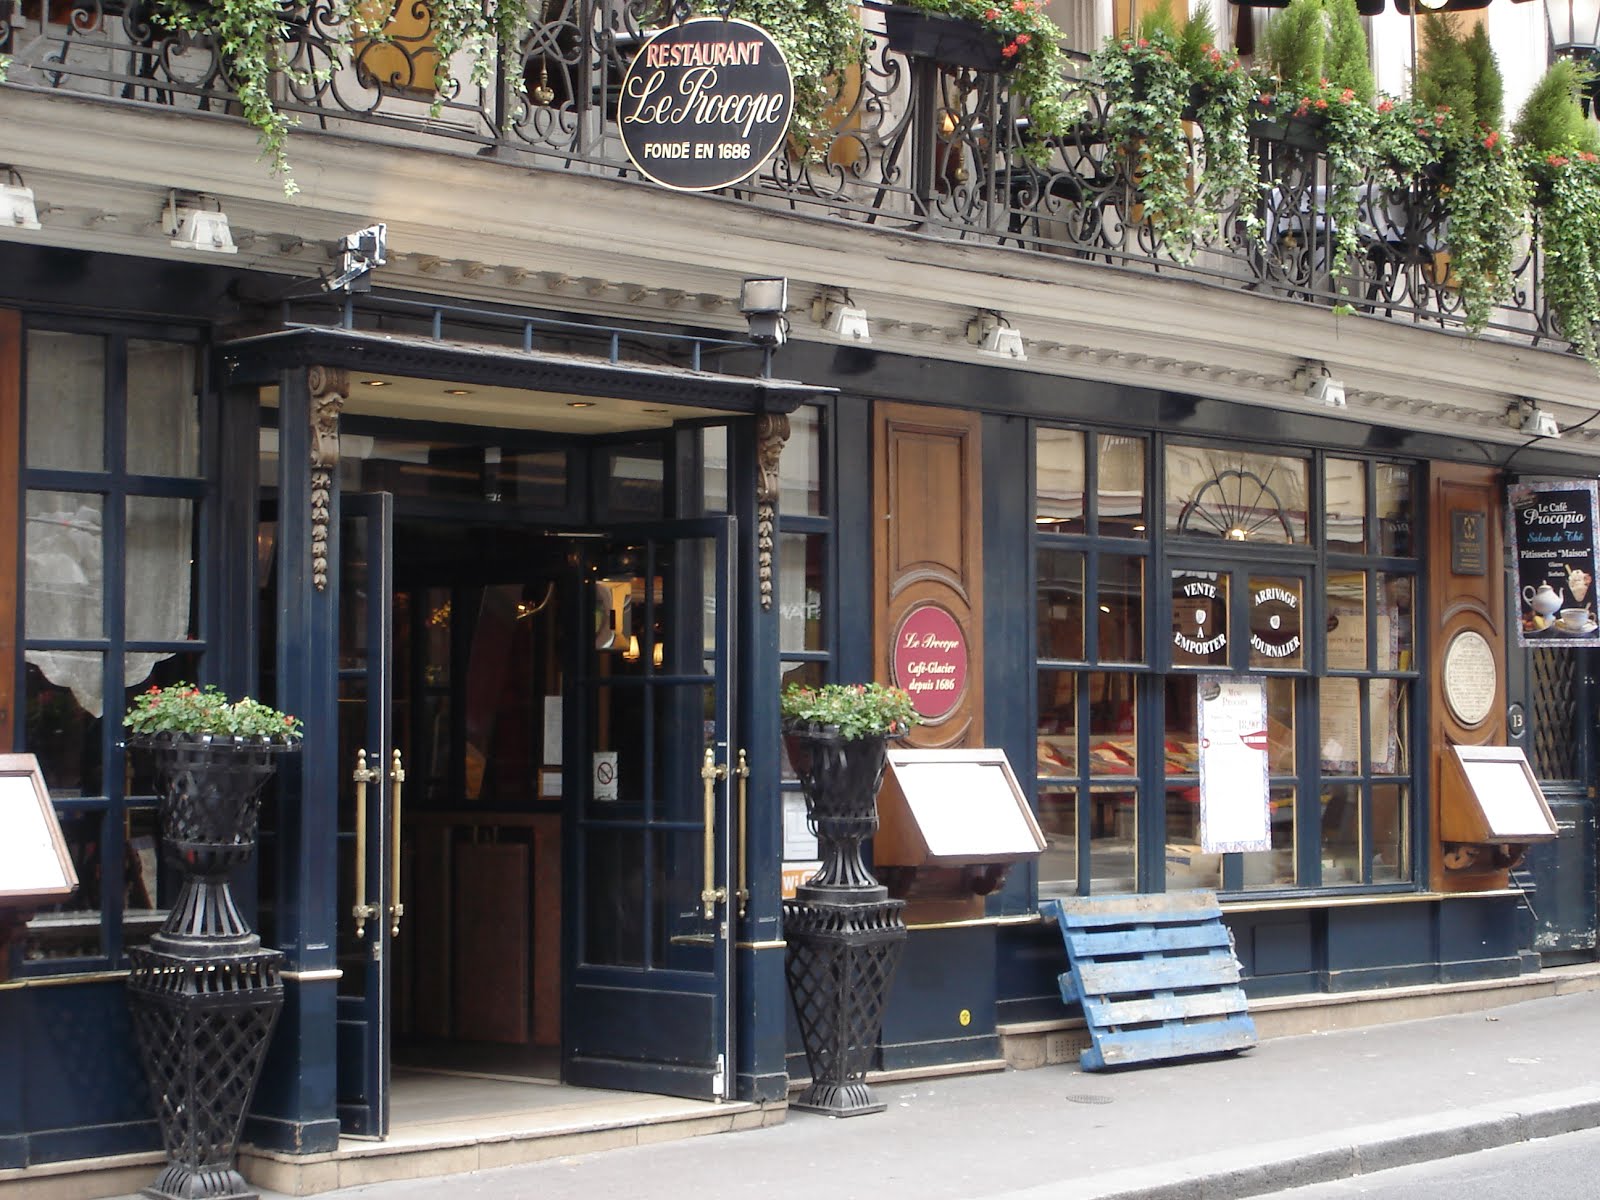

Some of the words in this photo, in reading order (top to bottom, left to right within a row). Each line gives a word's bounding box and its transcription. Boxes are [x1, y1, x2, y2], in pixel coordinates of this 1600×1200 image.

[646, 40, 763, 68] RESTAURANT
[624, 70, 673, 124] Le
[670, 66, 783, 138] Procope
[644, 141, 690, 159] FONDÉ
[695, 143, 713, 159] EN
[718, 143, 750, 159] 1686
[1538, 503, 1548, 512] Le
[1549, 502, 1568, 512] Café
[1523, 508, 1586, 529] Procopio
[1527, 532, 1551, 543] Salon
[1552, 532, 1562, 542] de
[1564, 530, 1584, 541] Thé
[1183, 582, 1217, 599] VENTE
[1254, 587, 1297, 609] ARRIVAGE
[1197, 626, 1204, 639] A
[903, 632, 920, 649] Le
[921, 633, 959, 652] Procope
[1174, 631, 1227, 655] EMPORTER
[1250, 634, 1300, 658] JOURNALIER
[907, 661, 956, 677] Café-Glacier
[908, 678, 934, 693] depuis
[935, 678, 955, 691] 1686
[1512, 714, 1523, 728] 13
